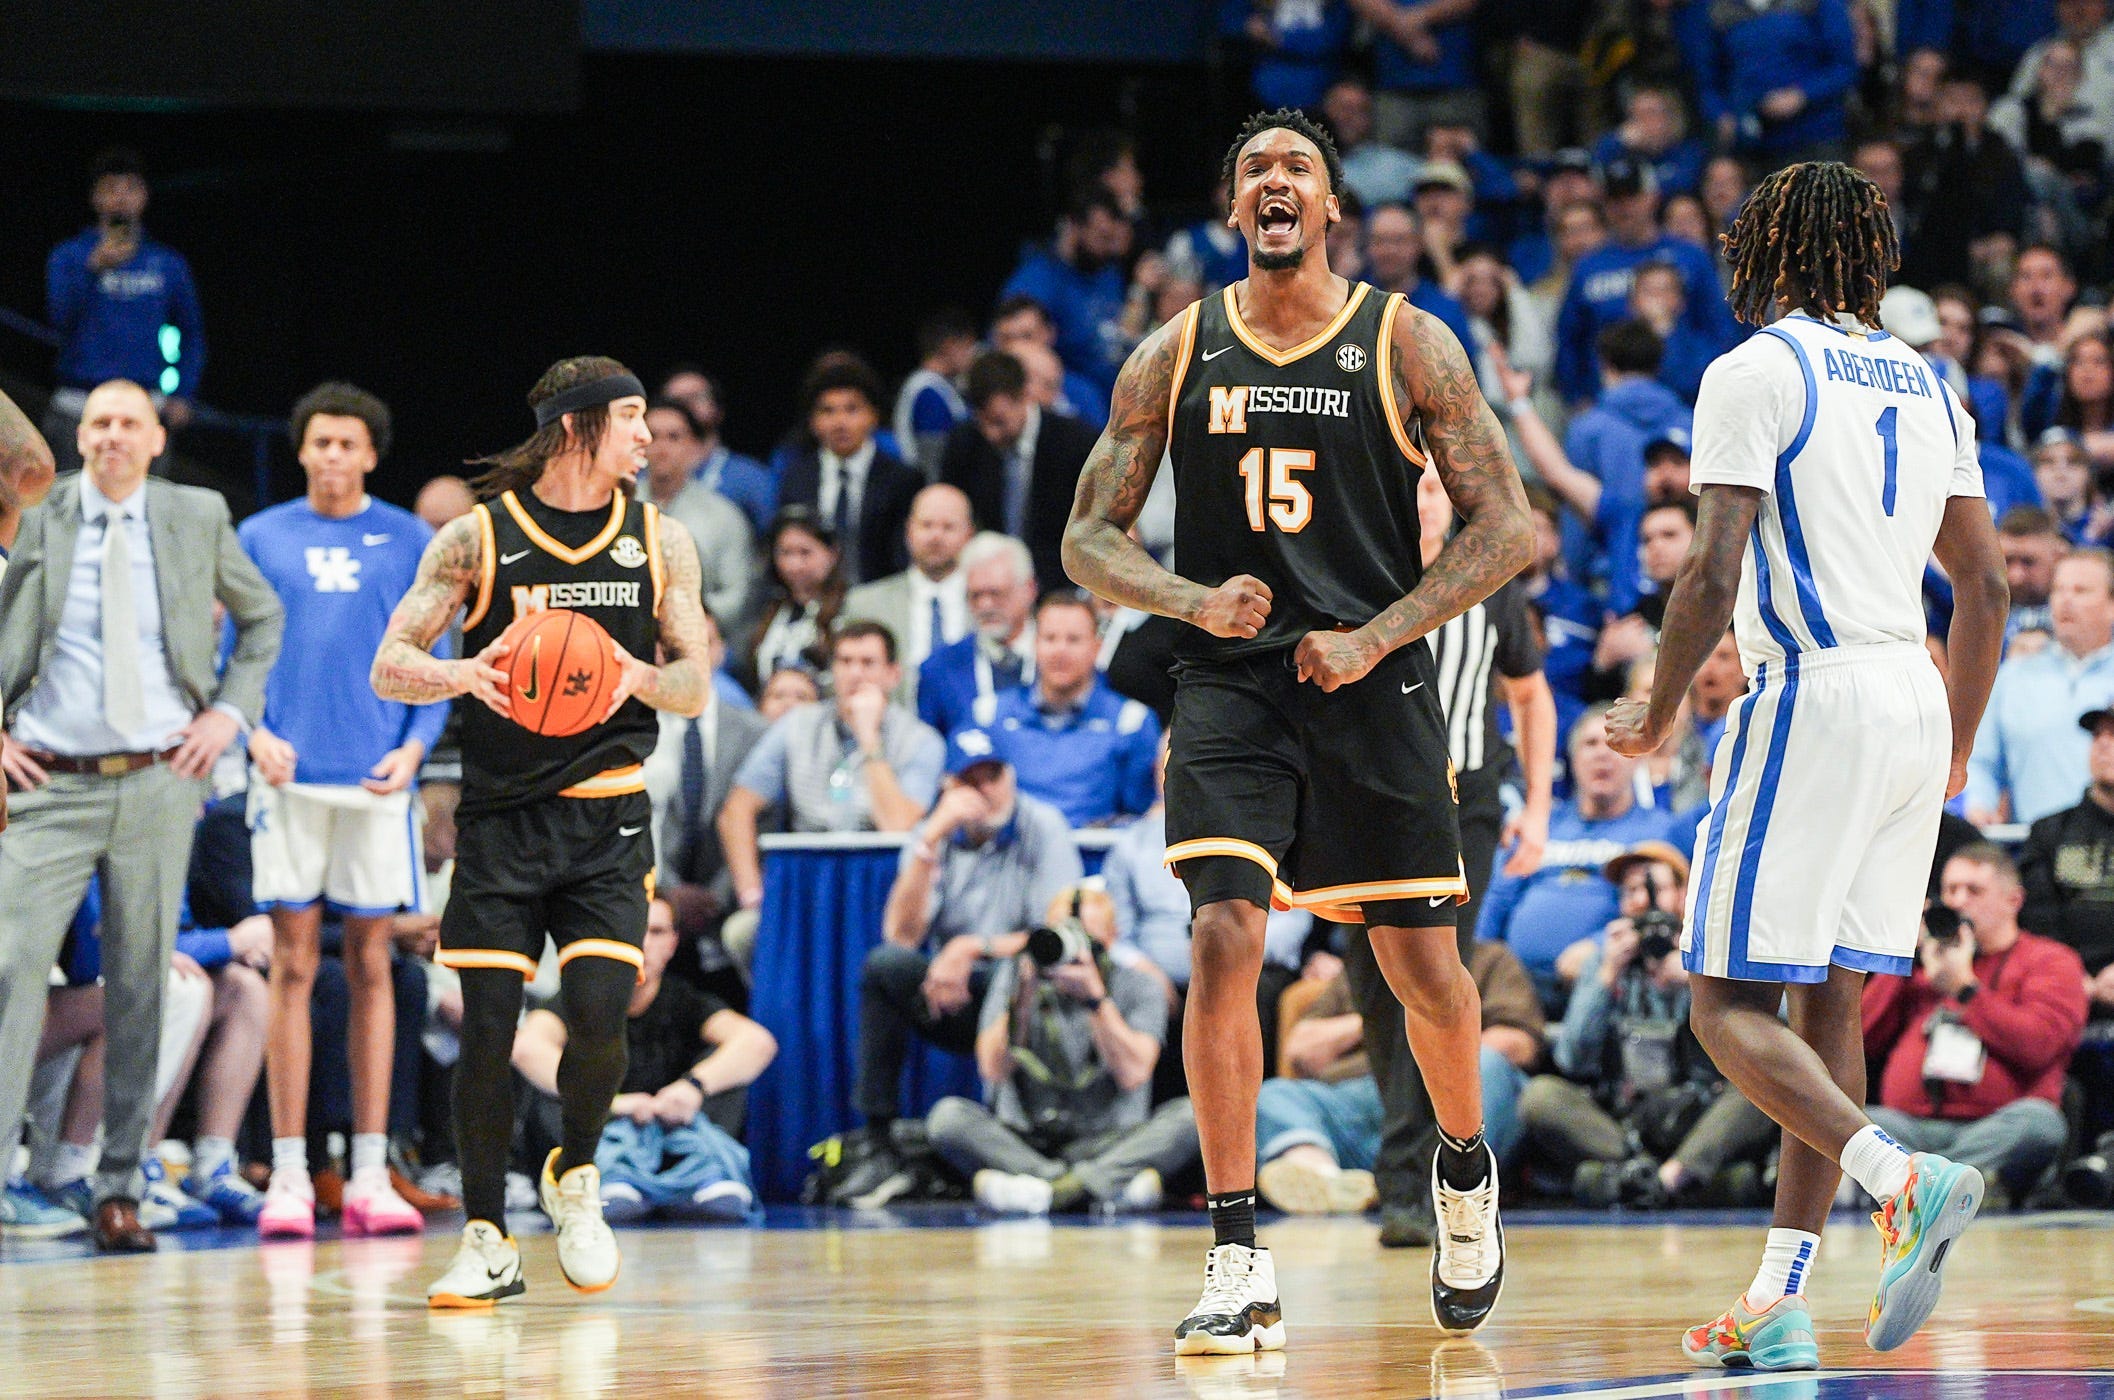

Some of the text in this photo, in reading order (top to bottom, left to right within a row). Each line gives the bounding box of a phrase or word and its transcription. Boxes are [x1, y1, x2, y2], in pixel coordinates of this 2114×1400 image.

[1338, 345, 1365, 370] SEC
[1823, 348, 1933, 399] ABERDEEN
[1208, 385, 1351, 434] MISSOURI
[1875, 406, 1898, 517] 1
[1238, 447, 1316, 534] 15
[511, 580, 641, 622] MISSOURI
